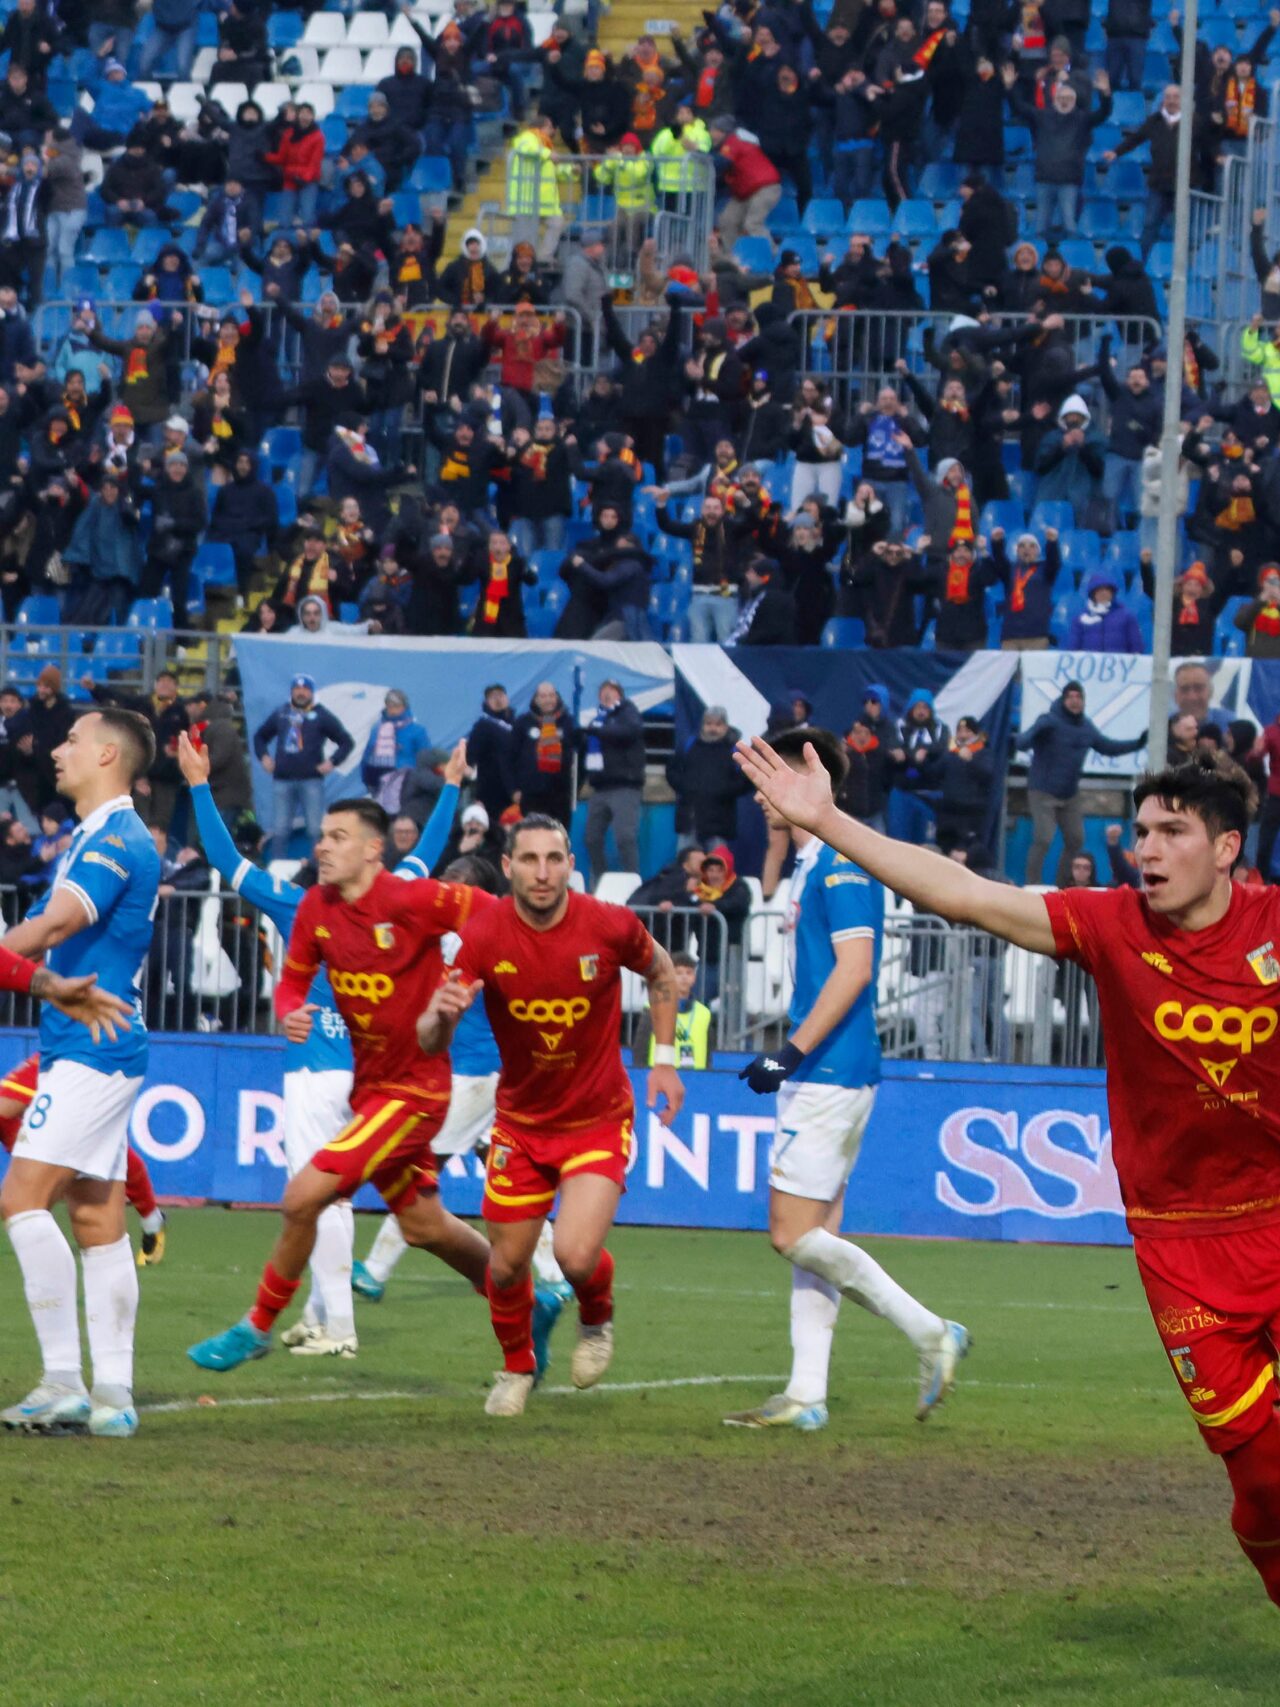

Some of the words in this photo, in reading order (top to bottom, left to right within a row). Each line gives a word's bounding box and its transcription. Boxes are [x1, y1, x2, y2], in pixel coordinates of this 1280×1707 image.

[1054, 653, 1137, 683] ROBY
[508, 997, 591, 1027] coop
[1154, 1000, 1279, 1054] coop
[935, 1106, 1126, 1219] SS
